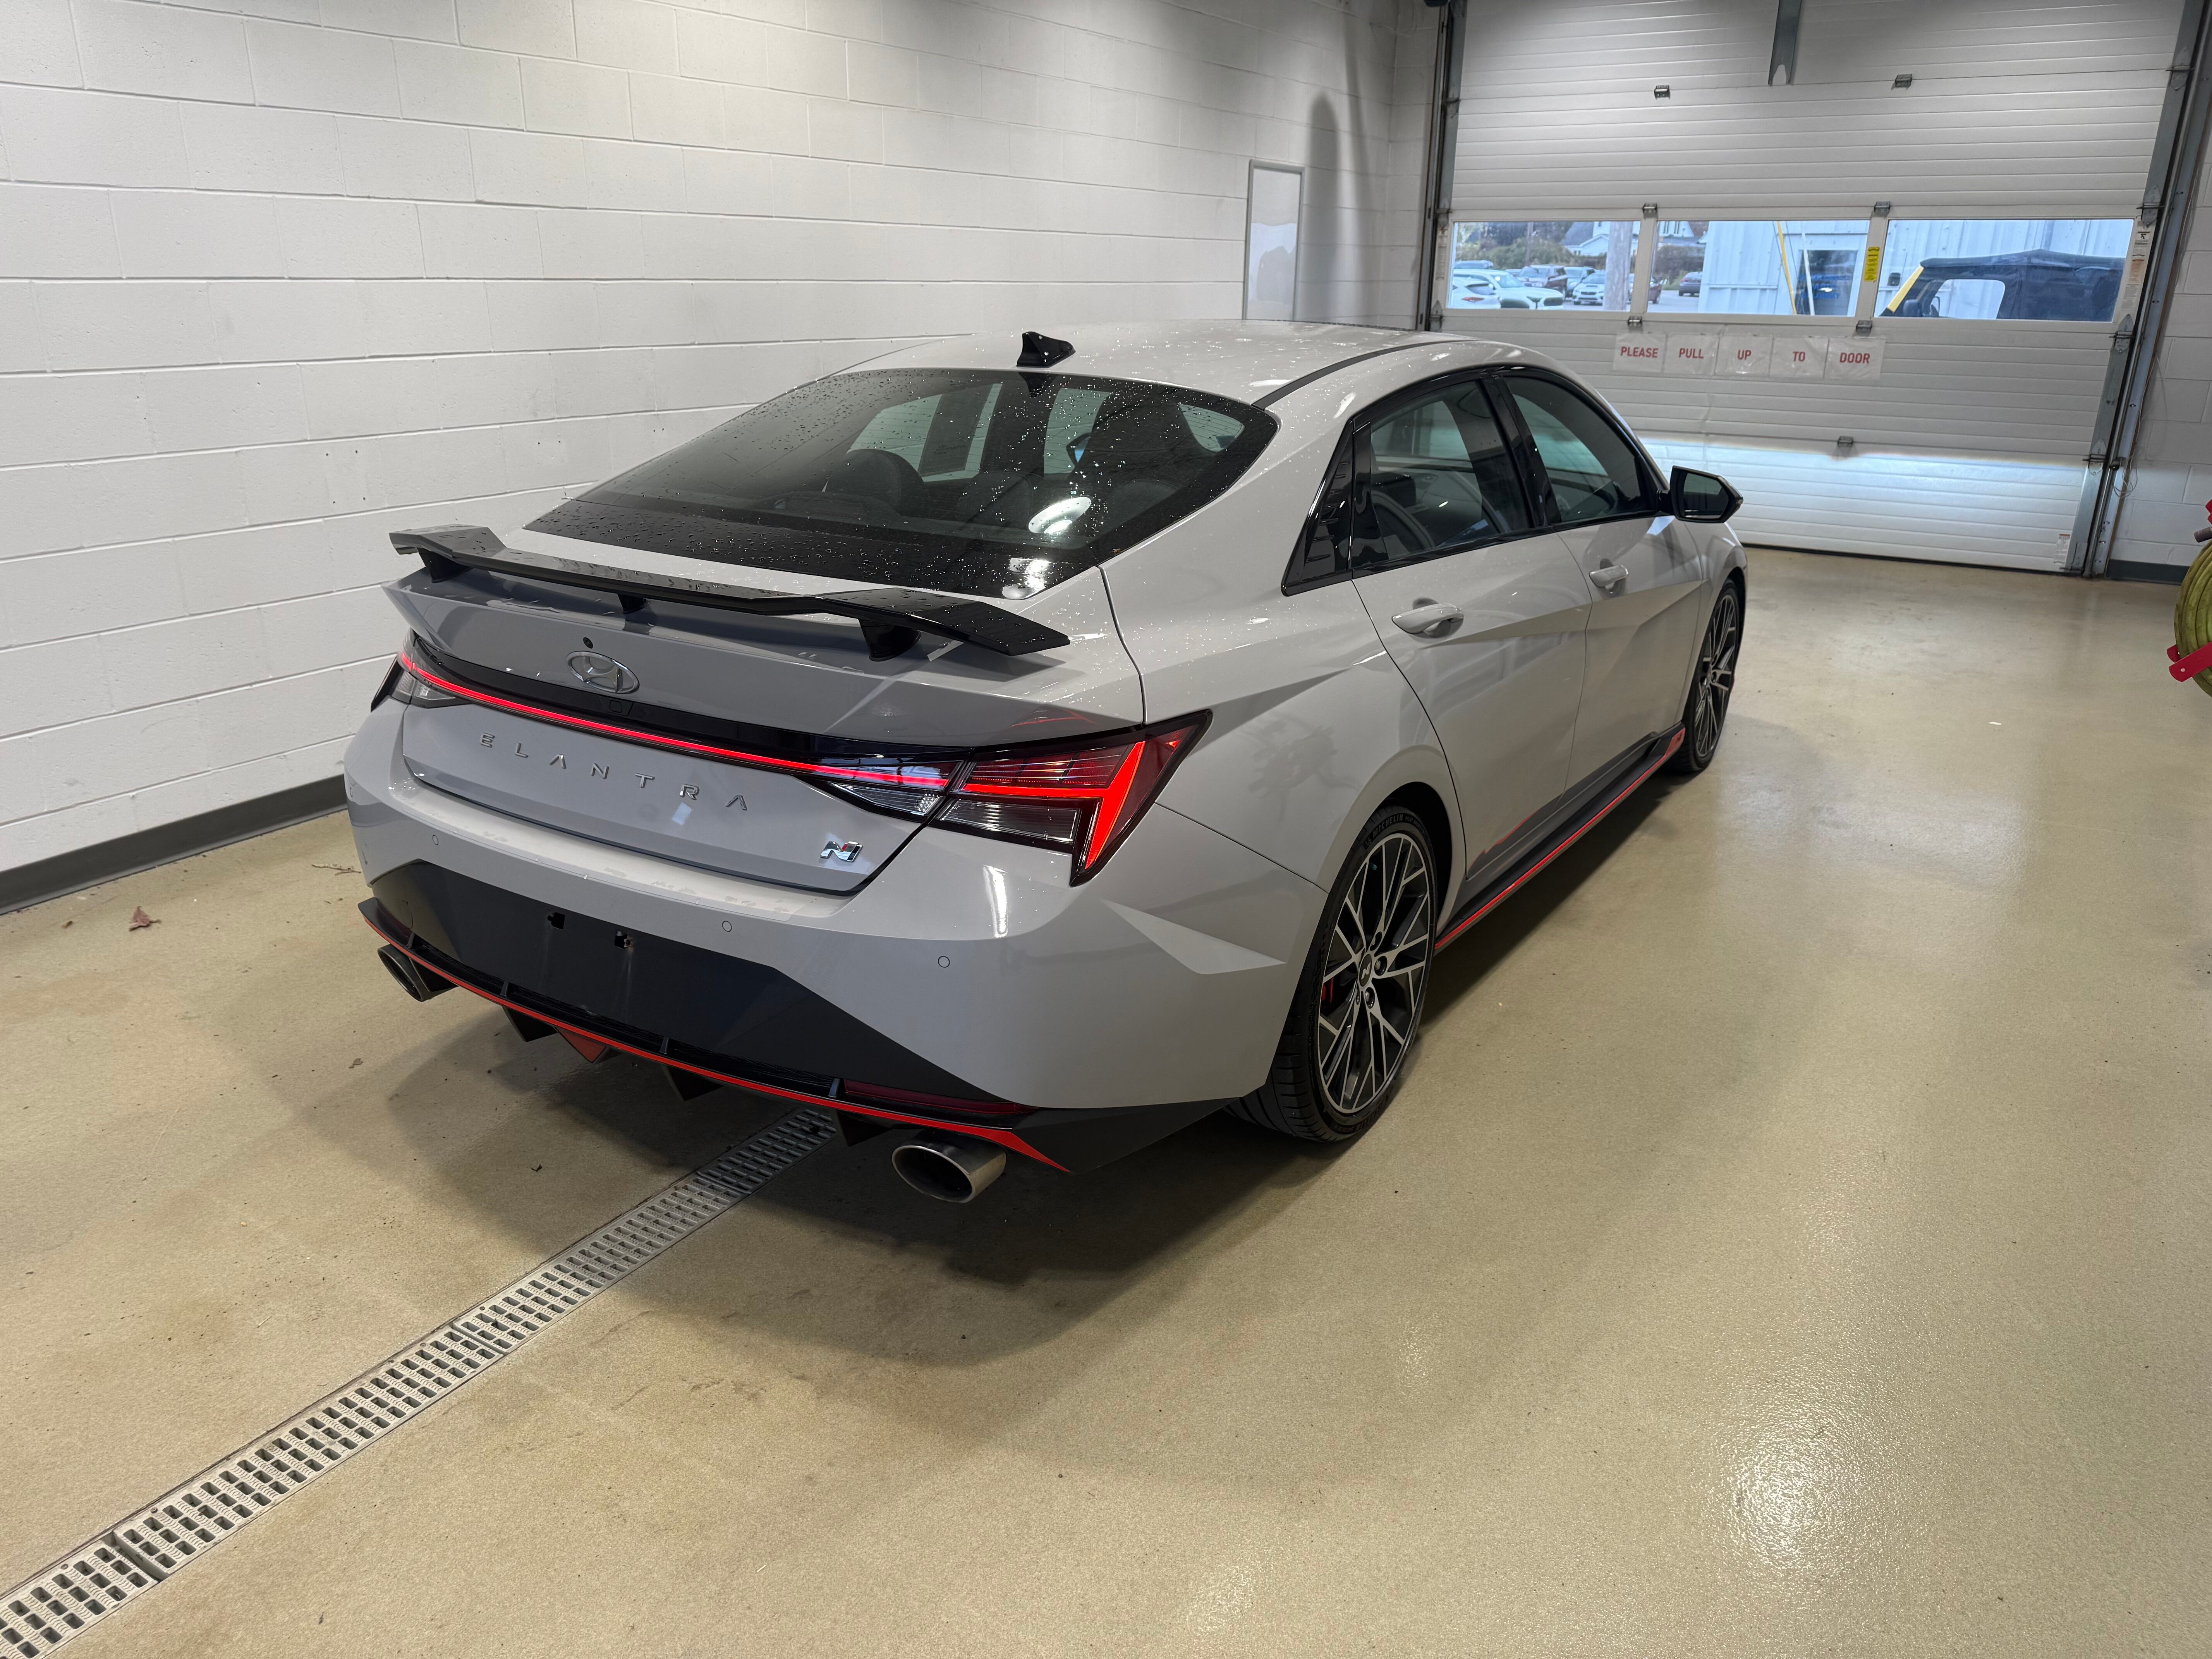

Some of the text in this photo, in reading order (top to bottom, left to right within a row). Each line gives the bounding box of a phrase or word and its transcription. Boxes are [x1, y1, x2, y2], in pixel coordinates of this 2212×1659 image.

[1620, 346, 1870, 364] PLEASE PULL UP TO DOOR
[480, 732, 747, 811] ELANTRA
[1372, 814, 1403, 839] MICHELIN
[820, 841, 863, 862] N
